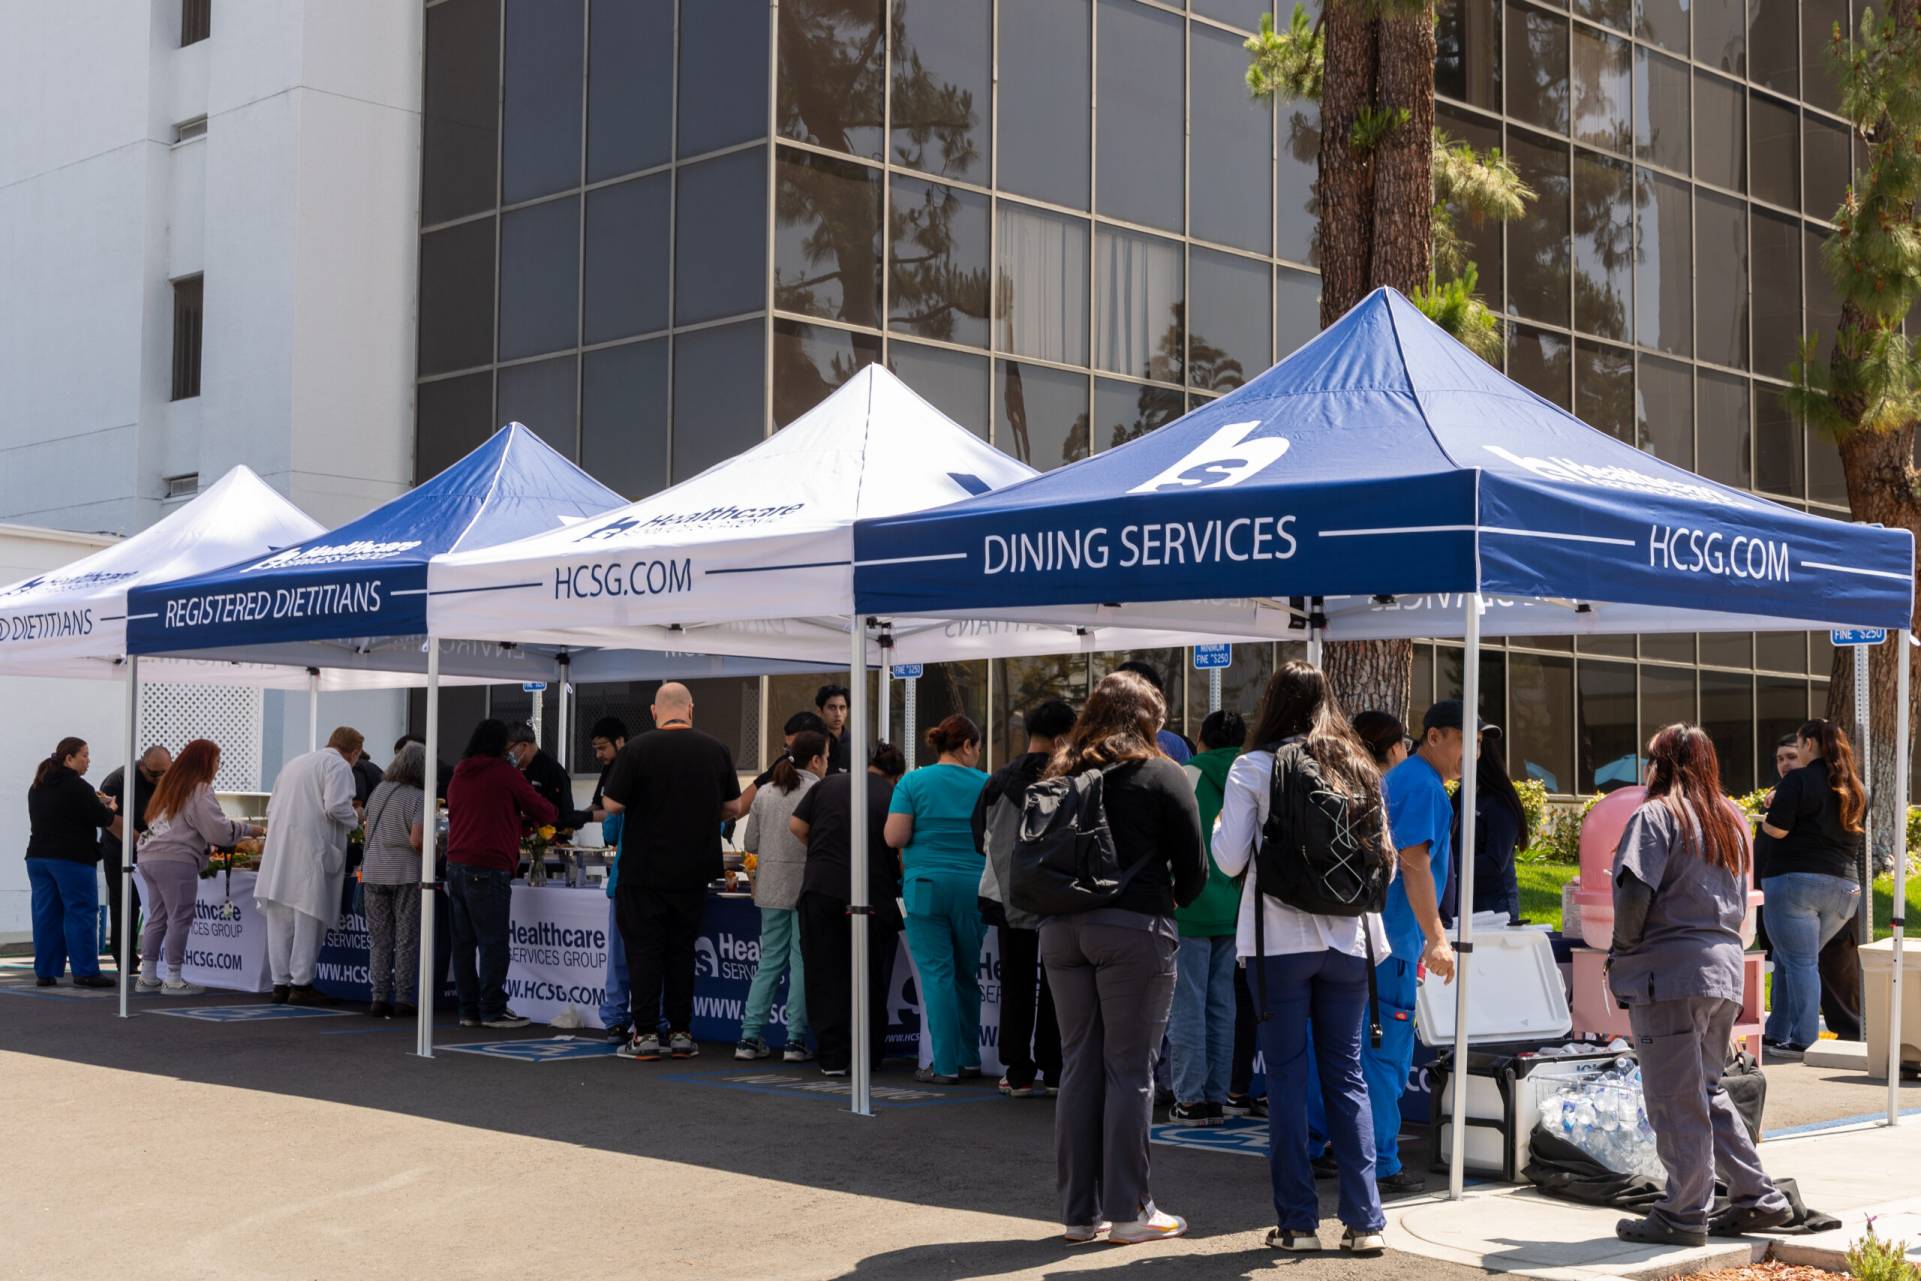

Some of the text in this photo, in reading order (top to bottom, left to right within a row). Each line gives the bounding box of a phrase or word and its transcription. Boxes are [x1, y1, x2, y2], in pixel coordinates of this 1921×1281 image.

[984, 515, 1297, 574] DINING SERVICES
[1649, 524, 1790, 582] HCSG.COM
[555, 558, 692, 599] HCSG.COM
[12, 609, 92, 640] DIETITIANS
[165, 581, 381, 628] REGISTERED DIETITIANS
[212, 923, 242, 938] GROUP
[563, 950, 607, 969] GROUP
